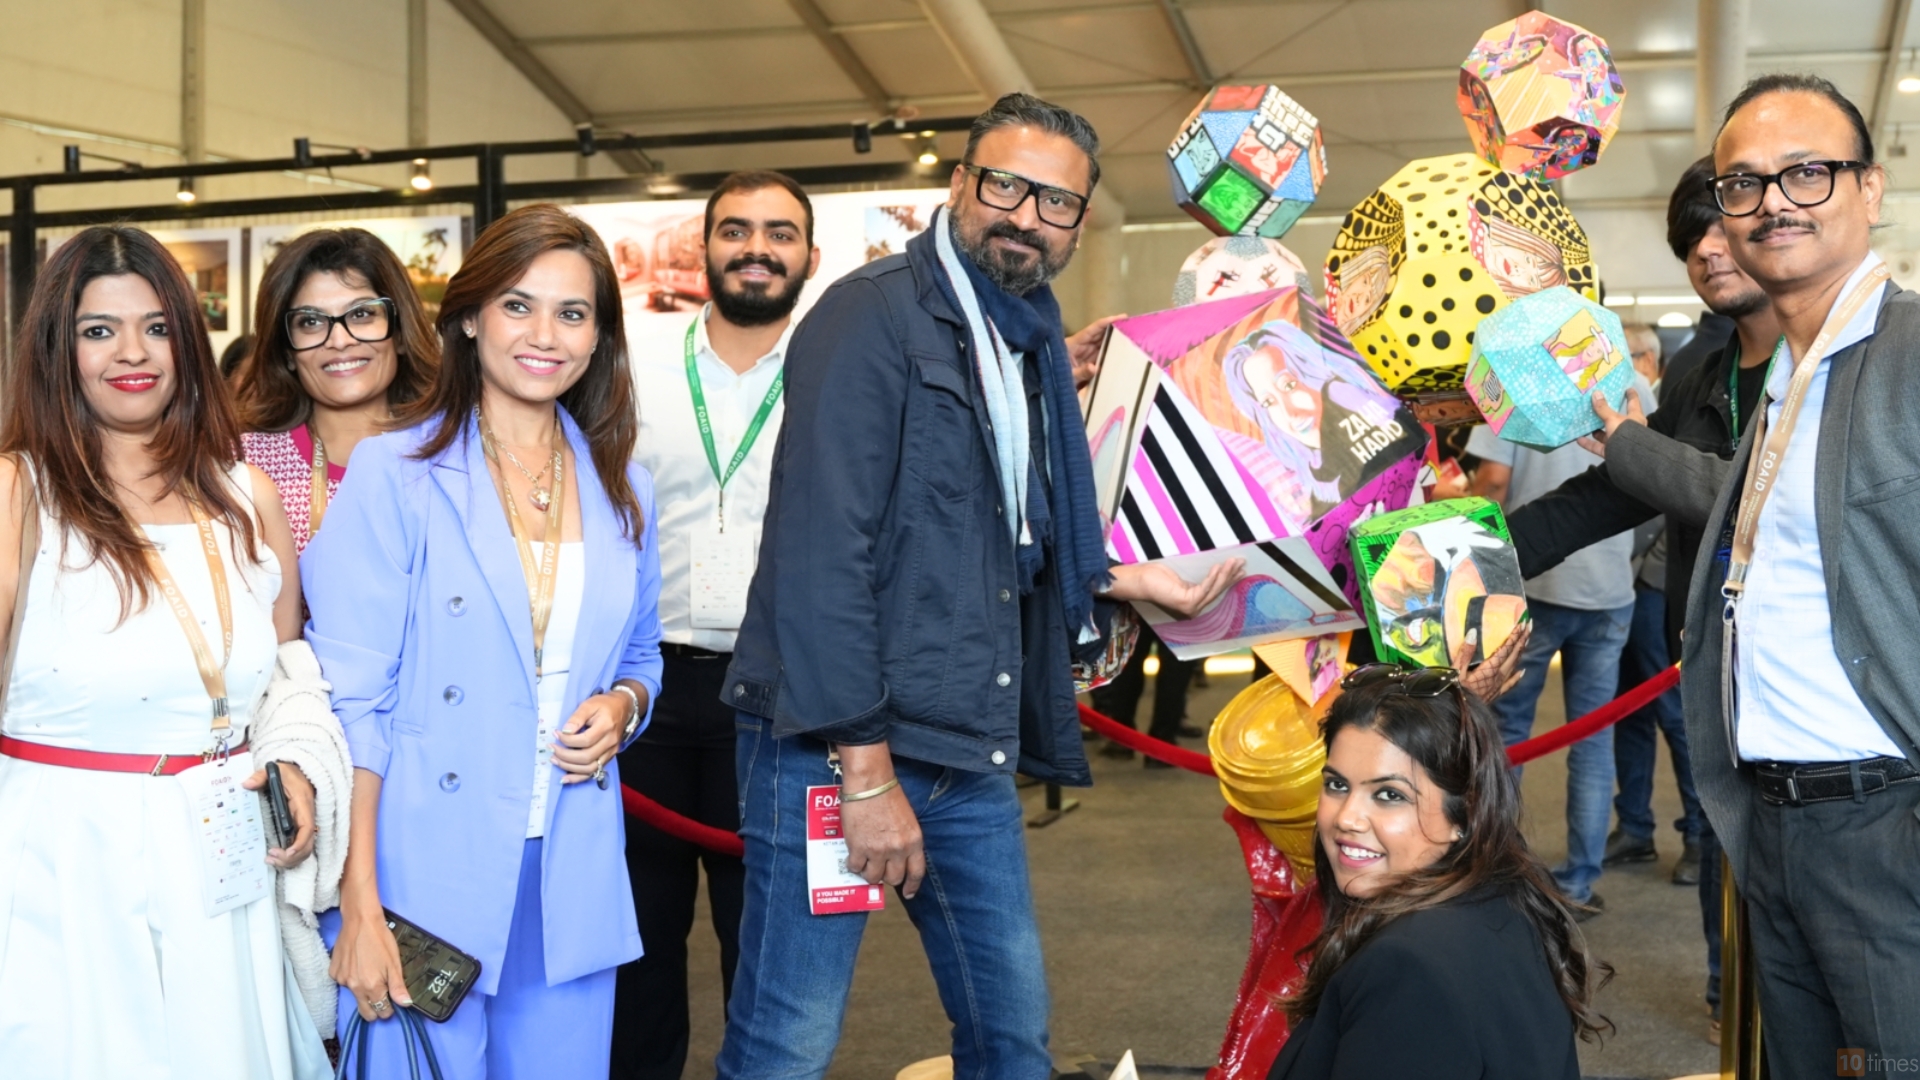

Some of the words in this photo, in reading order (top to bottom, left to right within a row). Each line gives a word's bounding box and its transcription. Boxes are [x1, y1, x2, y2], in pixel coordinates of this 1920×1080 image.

[1801, 332, 1831, 372] FOAID
[764, 379, 783, 406] FOAID
[697, 405, 710, 434] FOAID
[1338, 400, 1389, 442] ZAHA
[1350, 419, 1403, 464] HADID
[554, 450, 562, 482] FOAID
[725, 451, 744, 479] FOAID
[1755, 450, 1778, 492] FOAID
[200, 520, 218, 556] FOAID
[543, 541, 556, 575] FOAID
[161, 579, 188, 618] FOAID
[815, 794, 841, 808] FOA
[428, 969, 451, 993] 1:32
